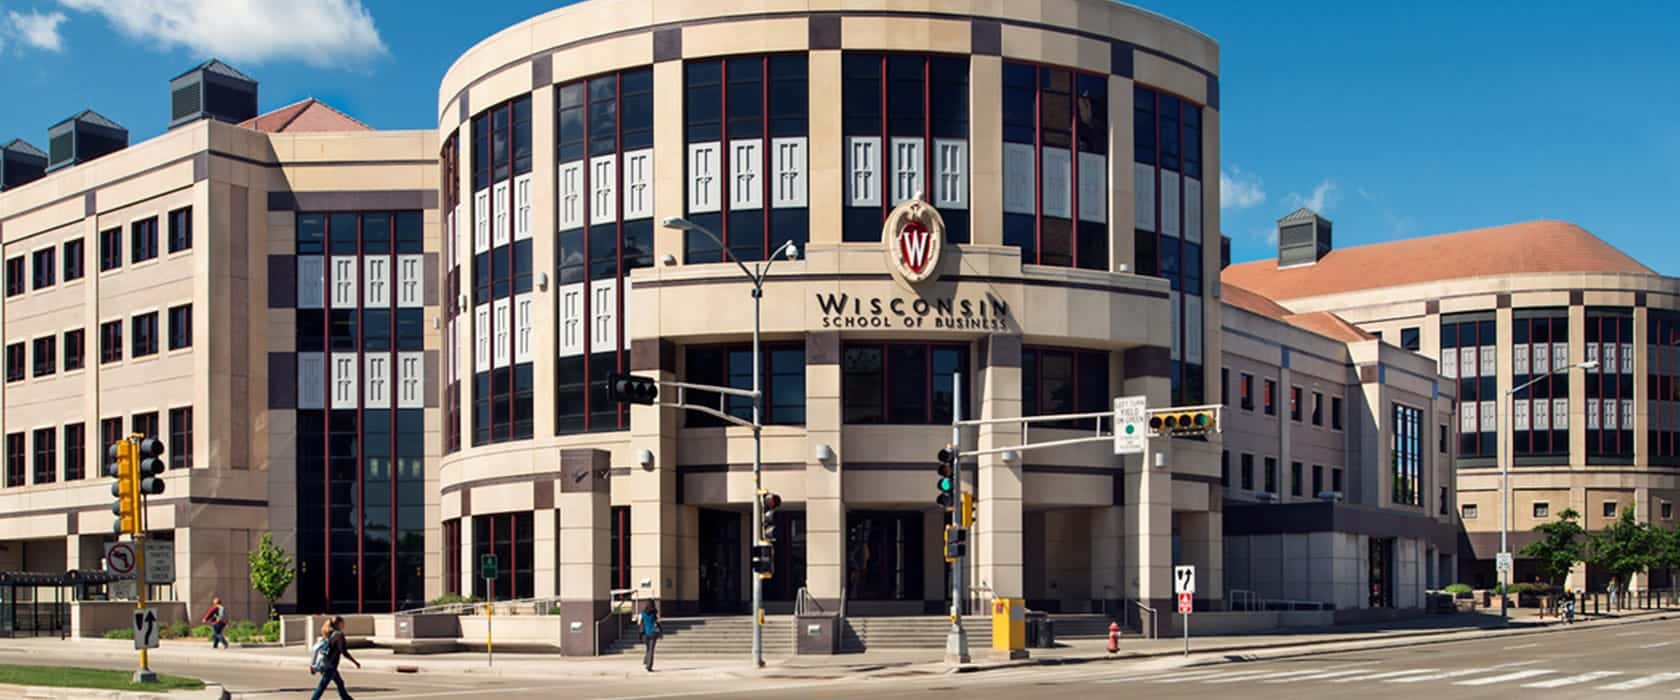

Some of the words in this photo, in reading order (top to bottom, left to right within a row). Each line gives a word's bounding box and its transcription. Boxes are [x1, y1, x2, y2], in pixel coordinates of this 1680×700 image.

[903, 229, 928, 267] W
[816, 293, 1008, 317] WISCONSIN
[823, 316, 891, 328] SCHOOL
[903, 316, 923, 328] OF
[936, 317, 1007, 329] BUSINESS
